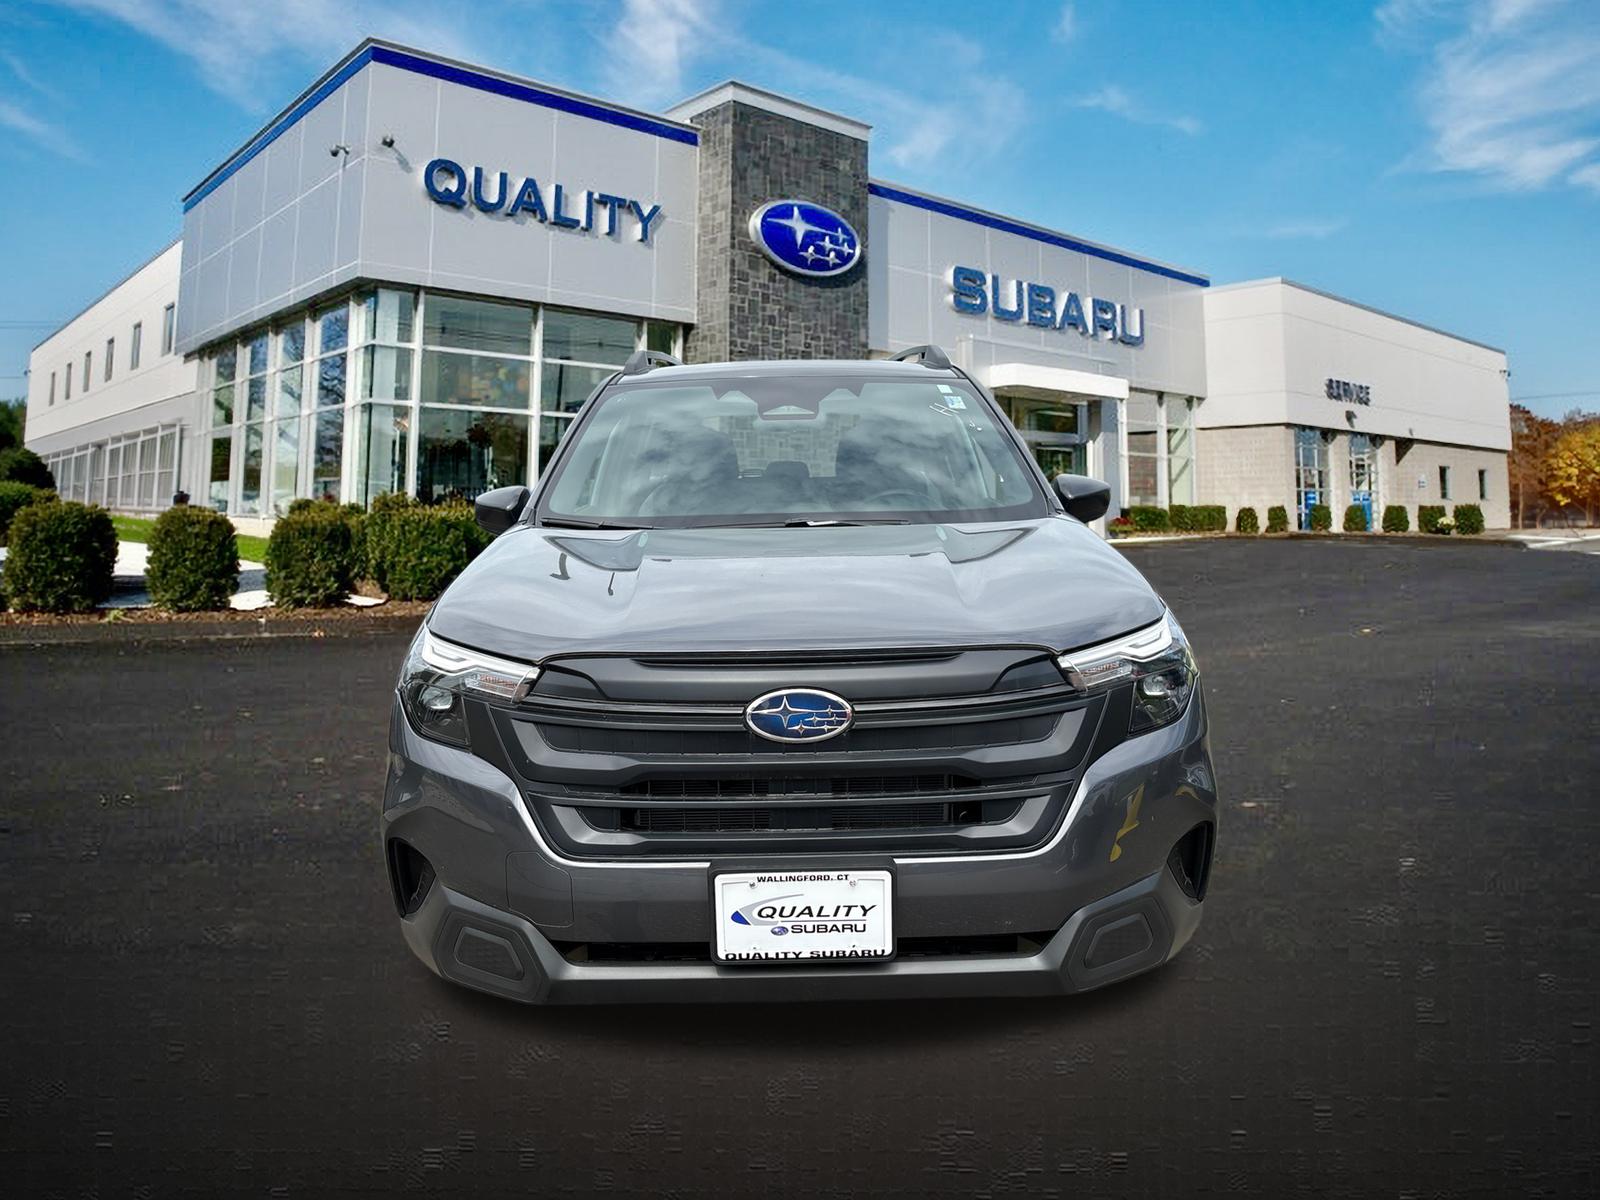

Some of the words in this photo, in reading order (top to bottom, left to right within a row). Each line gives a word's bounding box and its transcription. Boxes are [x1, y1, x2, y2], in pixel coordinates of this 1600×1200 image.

[424, 158, 662, 242] QUALITY
[947, 265, 1145, 346] SUBARU
[837, 873, 849, 881] CT
[757, 904, 877, 919] QUALITY
[791, 923, 866, 934] SUBARU
[725, 951, 803, 960] QUALITY
[809, 948, 885, 958] SUBARU
